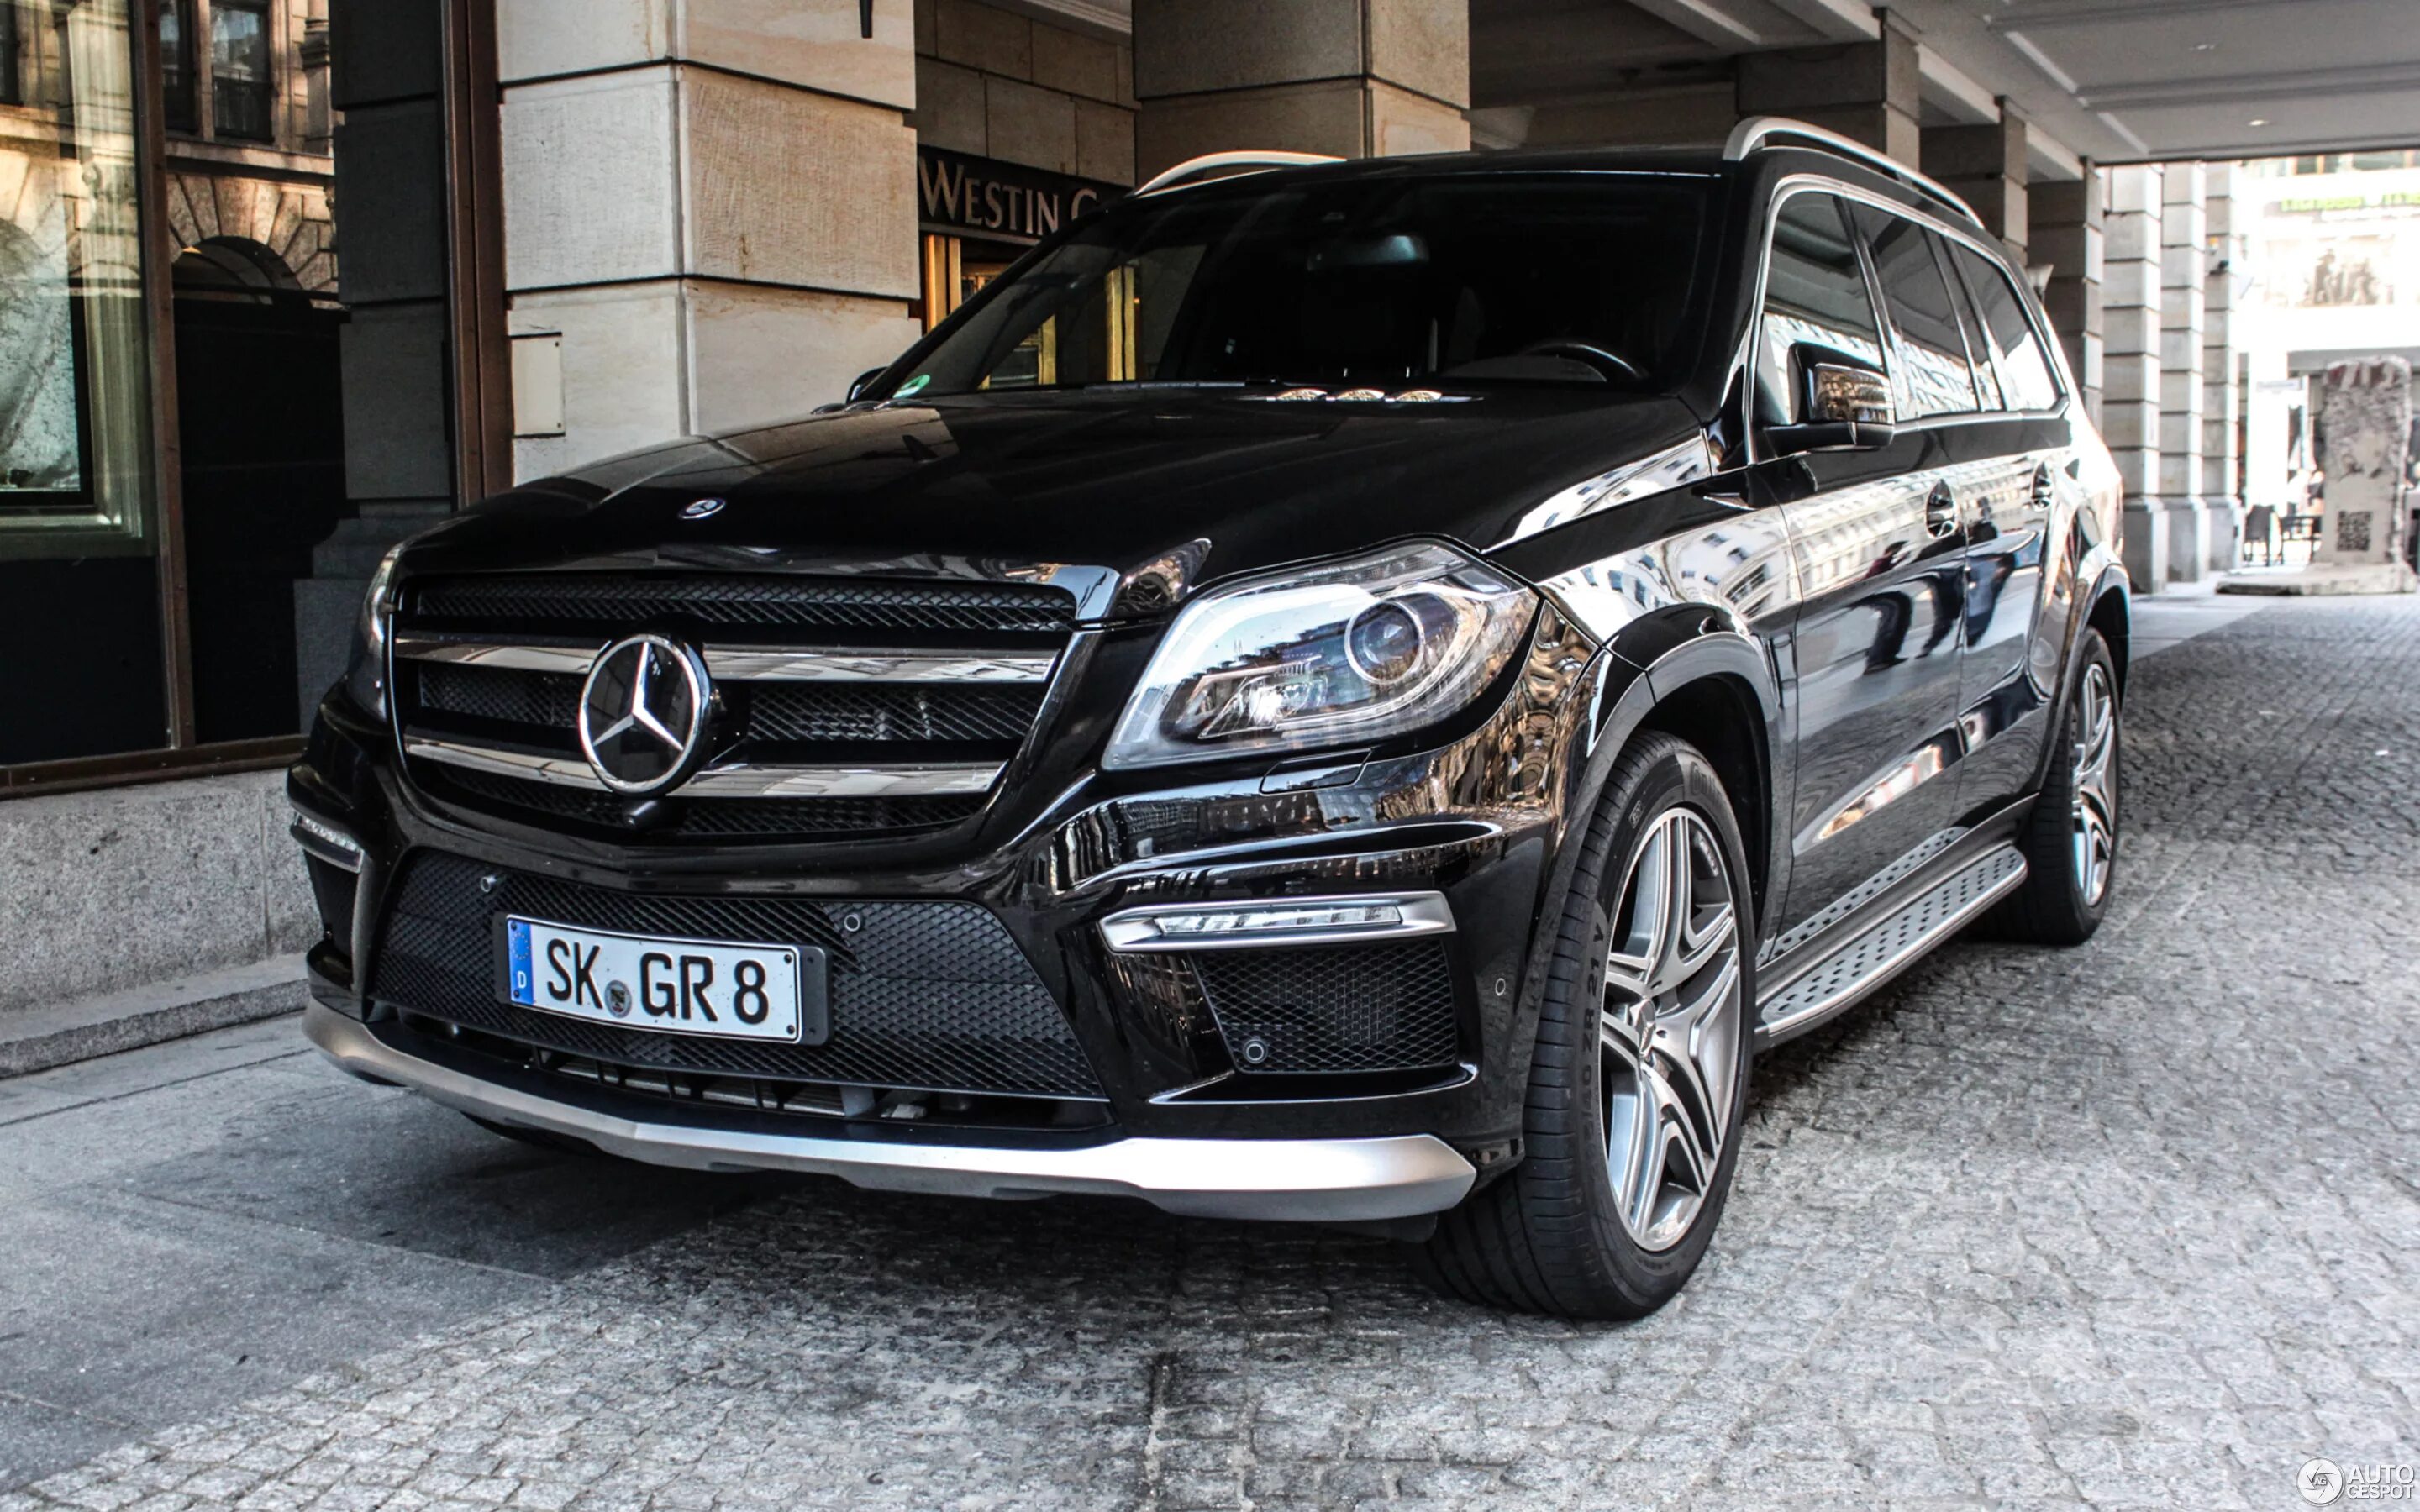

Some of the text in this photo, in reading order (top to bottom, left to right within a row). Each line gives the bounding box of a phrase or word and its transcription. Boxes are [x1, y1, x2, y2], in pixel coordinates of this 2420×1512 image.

[919, 157, 1059, 236] WESTIN
[516, 970, 528, 990] D
[547, 938, 769, 1025] SK GR 8
